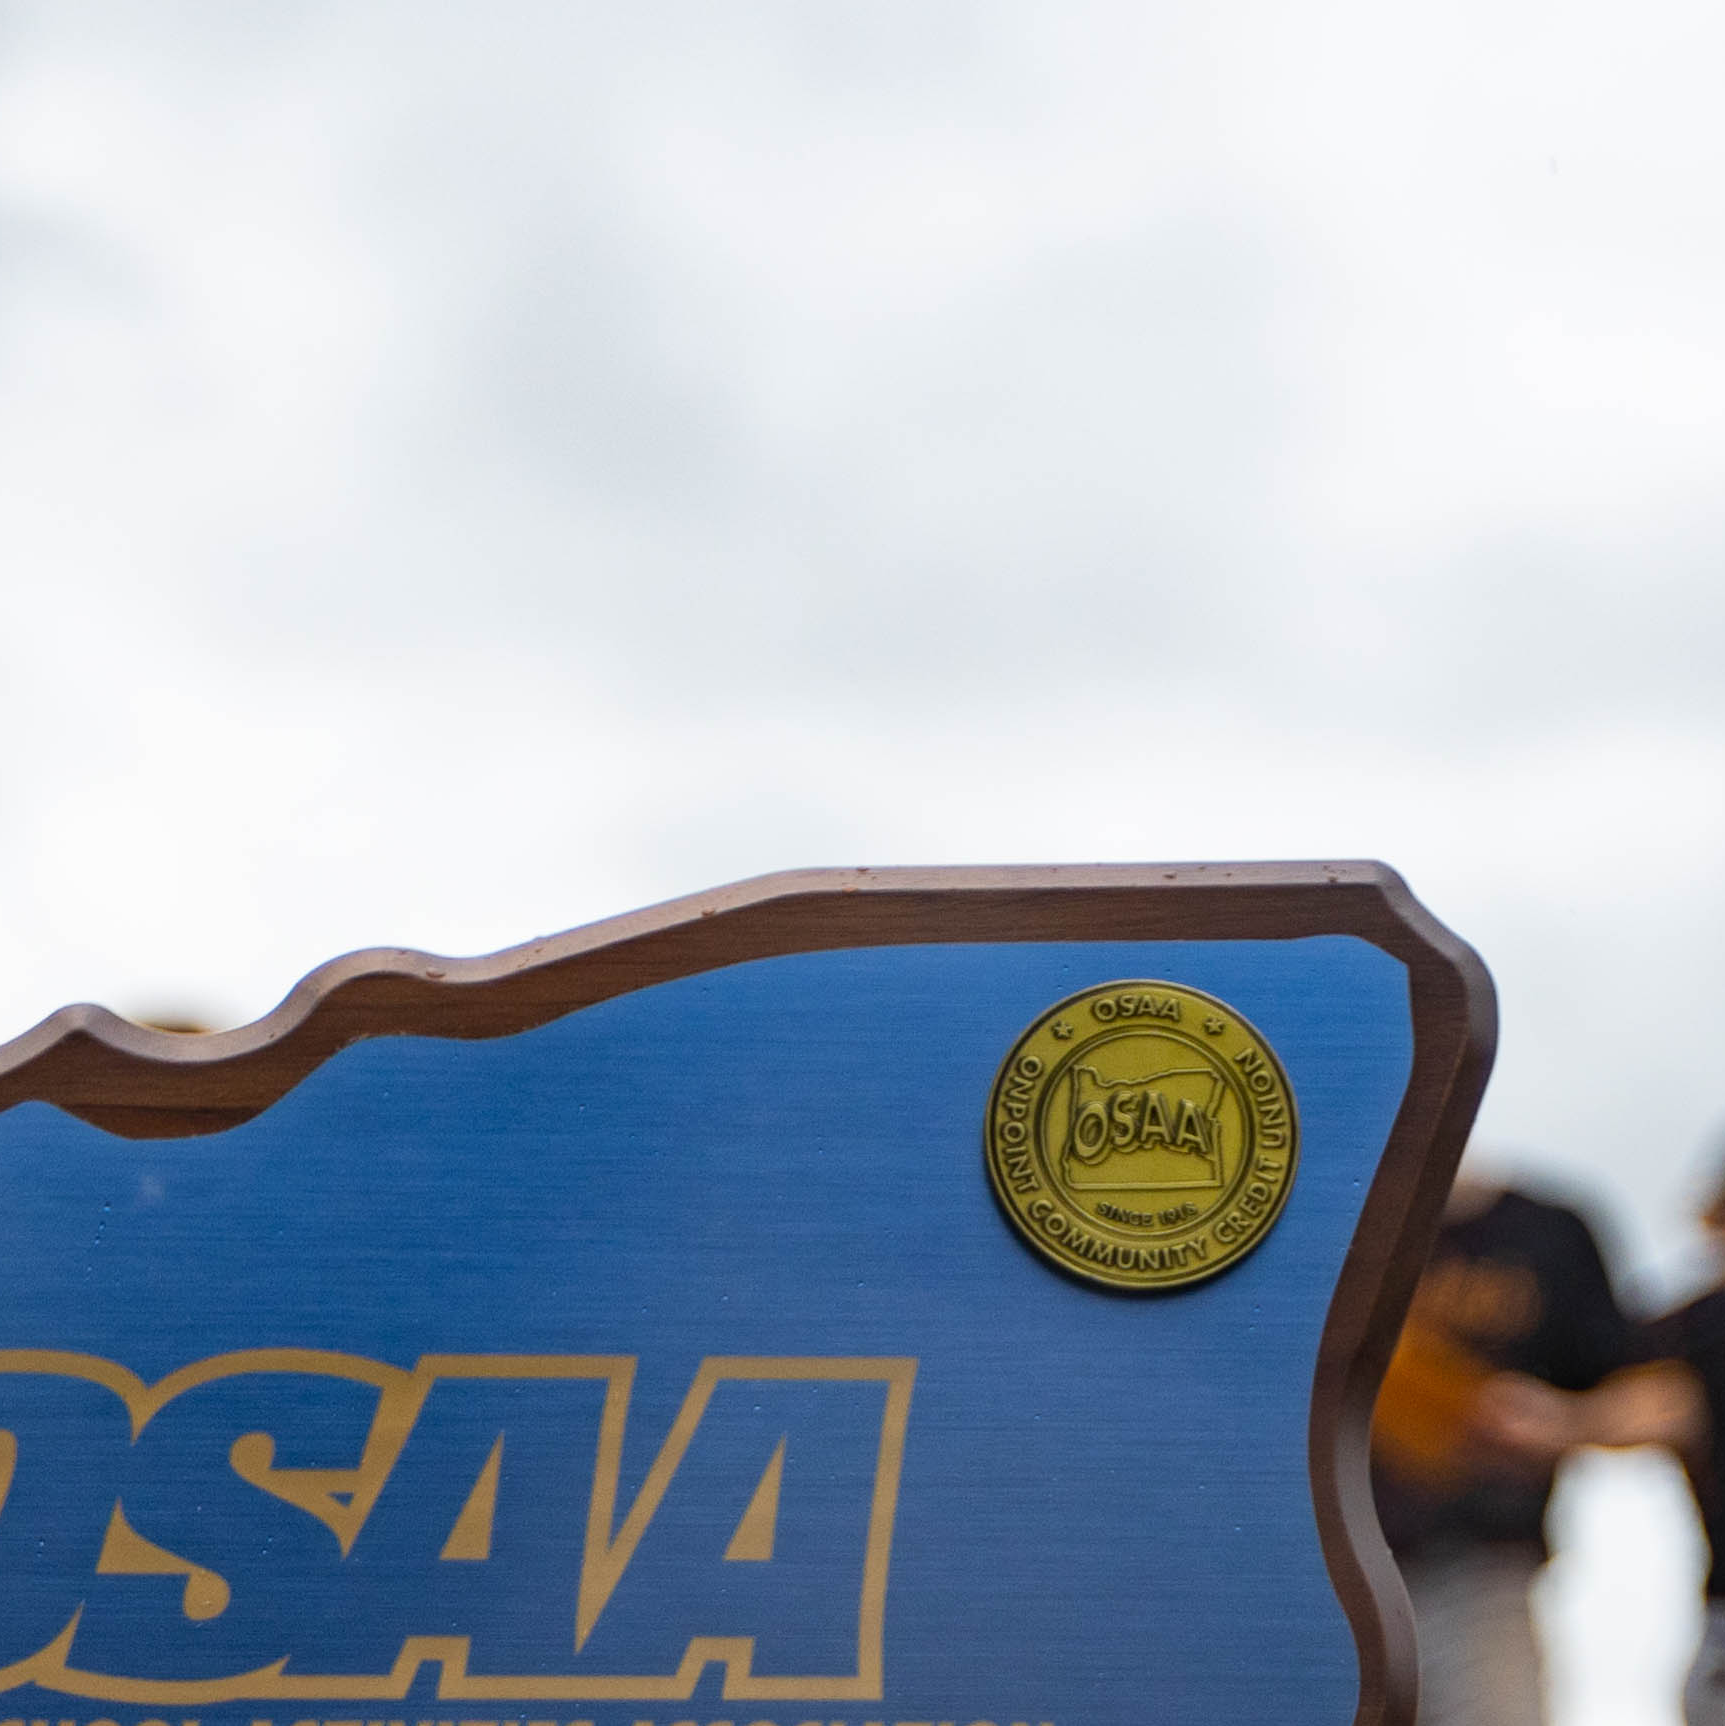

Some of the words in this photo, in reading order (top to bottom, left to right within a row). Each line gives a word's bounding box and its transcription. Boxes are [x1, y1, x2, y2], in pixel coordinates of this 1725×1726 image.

[1091, 995, 1183, 1023] OSAA
[1002, 1054, 1044, 1195] ONPOINT
[1074, 1090, 1209, 1164] OSAA
[1234, 1047, 1289, 1151] UNION
[1028, 1198, 1209, 1272] COMMUNITY
[1097, 1201, 1153, 1226] SINCE
[1212, 1157, 1283, 1245] CREDIT
